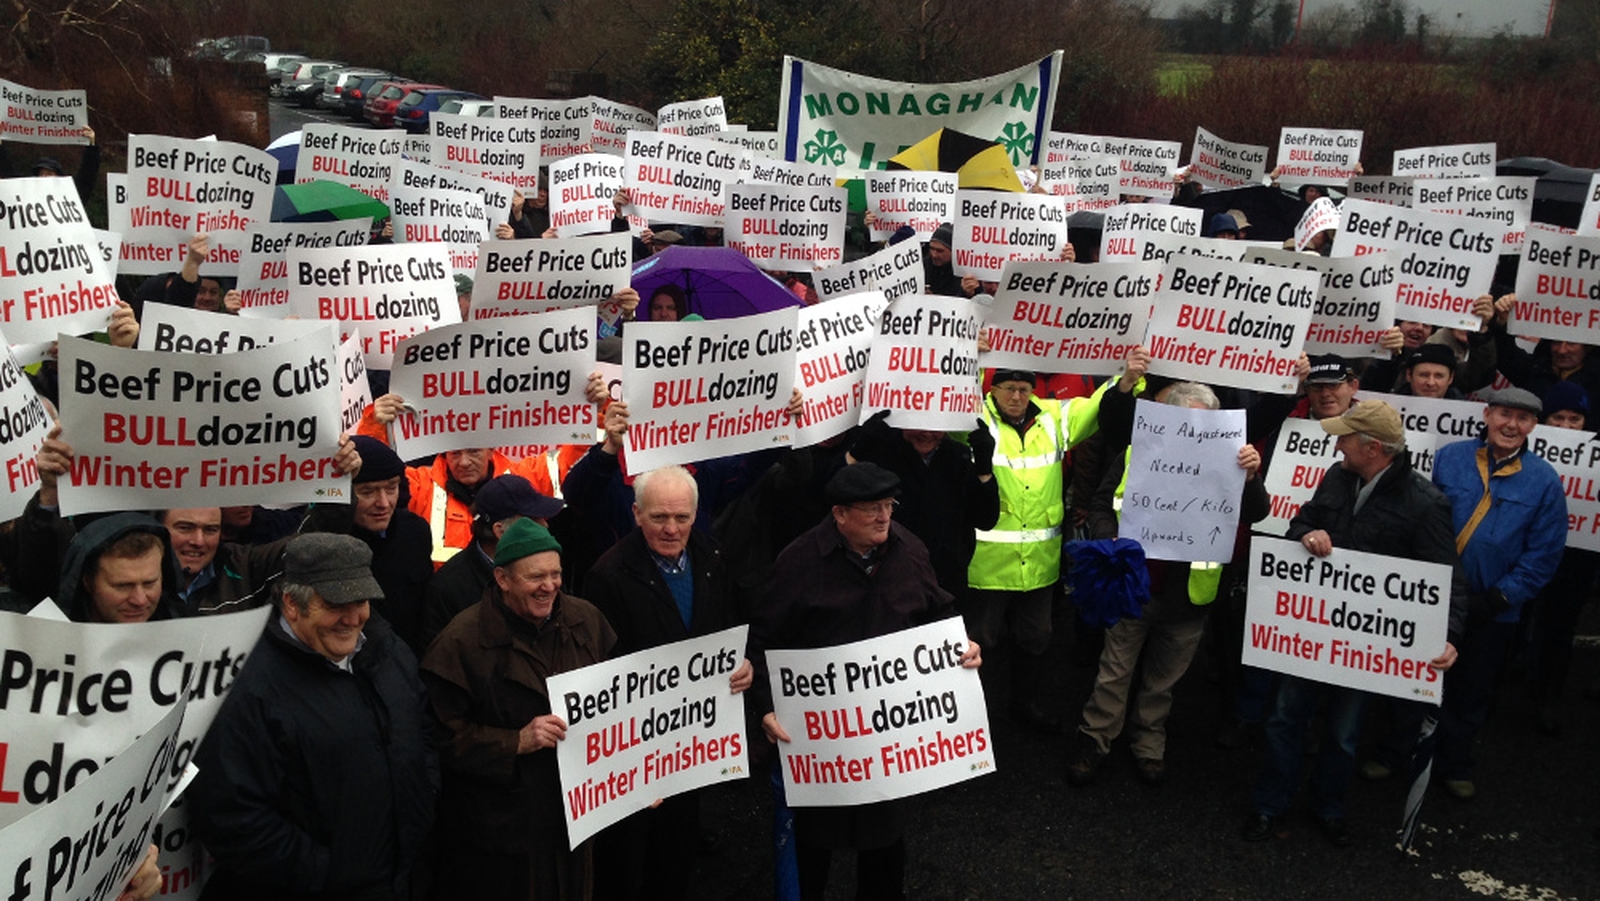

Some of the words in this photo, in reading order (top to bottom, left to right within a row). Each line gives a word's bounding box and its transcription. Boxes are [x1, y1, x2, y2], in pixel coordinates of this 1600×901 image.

[26, 94, 53, 108] Price
[57, 96, 82, 108] Cuts
[499, 105, 528, 119] Beef
[532, 107, 560, 121] Price
[564, 103, 589, 118] Cuts
[678, 107, 702, 123] Price
[704, 104, 724, 117] Cuts
[804, 82, 1039, 119] MONAGHAN
[7, 107, 75, 125] BULLdozing
[304, 132, 337, 149] Beef
[342, 135, 376, 155] Price
[436, 121, 468, 140] Beef
[471, 125, 504, 143] Price
[508, 127, 536, 143] Cuts
[1284, 133, 1308, 147] Beef
[1309, 134, 1334, 148] Price
[1336, 135, 1358, 148] Cuts
[447, 145, 525, 170] BULLdozing
[631, 140, 664, 160] Beef
[667, 144, 702, 167] Price
[706, 150, 736, 171] Cuts
[1066, 139, 1089, 153] Price
[1104, 143, 1128, 159] Beef
[1128, 144, 1153, 159] Price
[1155, 146, 1176, 160] Cuts
[1215, 143, 1237, 160] Price
[1240, 149, 1263, 163] Cuts
[1289, 149, 1349, 166] BULLdozing
[135, 147, 178, 169] Beef
[184, 151, 226, 174] Price
[232, 155, 272, 185] Cuts
[312, 155, 391, 182] BULLdozing
[553, 162, 581, 184] Beef
[583, 160, 617, 180] Price
[1044, 165, 1067, 181] Beef
[1068, 163, 1093, 179] Price
[1095, 163, 1117, 176] Cuts
[1199, 152, 1253, 179] BULLdozing
[1398, 155, 1425, 171] Beef
[1428, 153, 1459, 168] Price
[1462, 152, 1491, 166] Cuts
[146, 177, 254, 210] BULLdozing
[637, 165, 722, 195] BULLdozing
[870, 179, 900, 194] Beef
[904, 180, 929, 193] Price
[932, 180, 955, 194] Cuts
[1052, 181, 1110, 197] BULLdozing
[1354, 181, 1385, 194] Beef
[732, 193, 765, 211] Beef
[770, 194, 806, 213] Price
[809, 195, 842, 213] Cuts
[1420, 188, 1453, 204] Beef
[1457, 186, 1492, 202] Price
[1496, 184, 1528, 201] Cuts
[47, 194, 82, 223] Cuts
[131, 207, 191, 231] Winter
[394, 198, 425, 217] Beef
[430, 199, 462, 218] Price
[879, 200, 947, 216] BULLdozing
[961, 200, 996, 219] Beef
[1000, 201, 1036, 221] Price
[1039, 205, 1063, 222] Cuts
[335, 229, 365, 246] Cuts
[405, 224, 483, 244] BULLdozing
[742, 218, 828, 240] BULLdozing
[971, 226, 1057, 251] BULLdozing
[1106, 215, 1129, 234] Beef
[1131, 213, 1167, 232] Price
[1170, 216, 1197, 237] Cuts
[1346, 212, 1391, 237] Beef
[1395, 219, 1443, 248] Price
[1449, 228, 1494, 254] Cuts
[486, 249, 534, 273] Beef
[537, 250, 585, 272] Price
[591, 246, 627, 269] Cuts
[780, 242, 840, 261] Finishers
[956, 250, 1005, 270] Winter
[1528, 240, 1572, 267] Beef
[299, 259, 351, 286] Beef
[357, 258, 404, 285] Price
[407, 256, 445, 281] Cuts
[821, 273, 855, 296] Beef
[860, 263, 893, 287] Price
[894, 247, 920, 271] Cuts
[1359, 265, 1394, 289] Cuts
[497, 280, 614, 302] BULLdozing
[1006, 272, 1058, 294] Beef
[1060, 274, 1108, 298] Price
[1113, 274, 1152, 300] Cuts
[1170, 267, 1221, 298] Beef
[1222, 274, 1273, 305] Price
[1276, 282, 1313, 310] Cuts
[318, 292, 441, 321] BULLdozing
[1013, 300, 1132, 335] BULLdozing
[1514, 301, 1582, 328] Winter
[819, 311, 863, 342] Price
[880, 308, 923, 336] Beef
[1177, 304, 1295, 350] BULLdozing
[403, 333, 462, 365] Beef
[470, 331, 531, 359] Price
[538, 325, 588, 356] Cuts
[635, 337, 692, 368] Beef
[698, 334, 749, 364] Price
[756, 328, 792, 352] Cuts
[986, 327, 1055, 357] Winter
[1149, 335, 1217, 366] Winter
[75, 359, 160, 400] Beef
[172, 364, 262, 402] Price
[272, 355, 329, 398] Cuts
[423, 365, 571, 400] BULLdozing
[652, 369, 778, 409] BULLdozing
[795, 392, 850, 428] Winter
[867, 382, 935, 411] Winter
[489, 400, 593, 430] Finishers
[628, 419, 701, 453] Winter
[706, 404, 791, 440] Finishers
[103, 411, 318, 449] BULLdozing
[1137, 415, 1166, 436] Price
[1177, 421, 1243, 444] Adjustment
[1285, 431, 1331, 457] Beef
[1533, 437, 1584, 468] Beef
[69, 455, 189, 489] Winter
[1150, 459, 1201, 477] Needed
[327, 488, 344, 498] IFA
[1131, 492, 1151, 509] 50
[1154, 497, 1178, 512] Cent
[1201, 497, 1234, 515] Kilo
[1141, 527, 1195, 546] Upwards
[1260, 552, 1315, 583] Beef
[1320, 561, 1376, 595] Price
[1384, 572, 1440, 606] Cuts
[1275, 590, 1416, 648] BULLdozing
[1251, 622, 1324, 662] Winter
[1329, 639, 1438, 683] Finishers
[780, 661, 838, 698] Beef
[844, 654, 908, 693] Price
[913, 638, 964, 675] Cuts
[0, 649, 133, 717] Price
[564, 675, 621, 727] Beef
[626, 663, 680, 704] Price
[687, 645, 737, 681] Cuts
[804, 689, 959, 741] BULLdozing
[586, 696, 717, 766] BULLdozing
[787, 752, 874, 784] Winter
[880, 728, 988, 777] Finishers
[568, 766, 638, 821] Winter
[643, 733, 742, 785] Finishers
